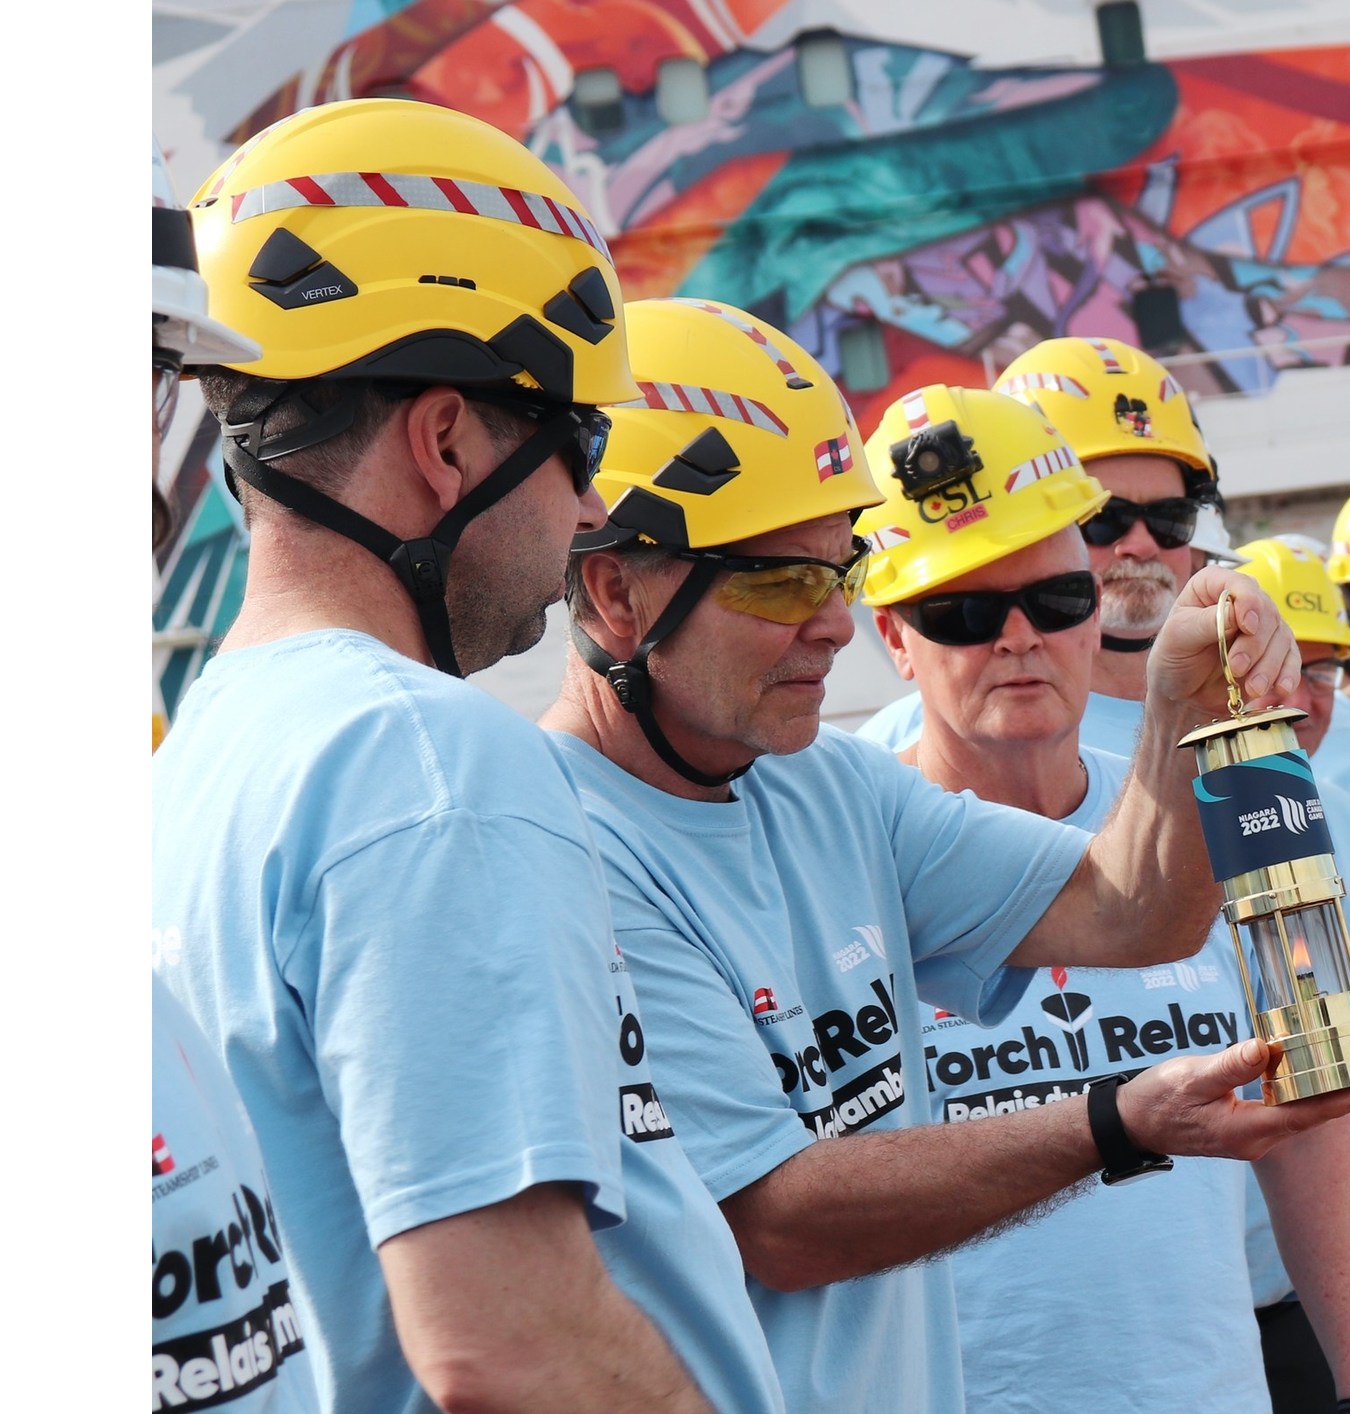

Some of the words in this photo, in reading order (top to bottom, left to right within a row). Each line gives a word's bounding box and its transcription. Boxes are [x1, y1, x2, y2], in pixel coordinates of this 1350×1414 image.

[301, 284, 343, 300] VERTEX
[918, 477, 992, 524] CSL
[947, 506, 986, 530] CHRIS
[1285, 591, 1329, 615] CSL
[1238, 807, 1277, 823] NIAGARA
[1240, 814, 1281, 837] 2022
[812, 974, 898, 1073] Rel
[1098, 1002, 1239, 1063] Relay
[152, 1192, 258, 1320] orch
